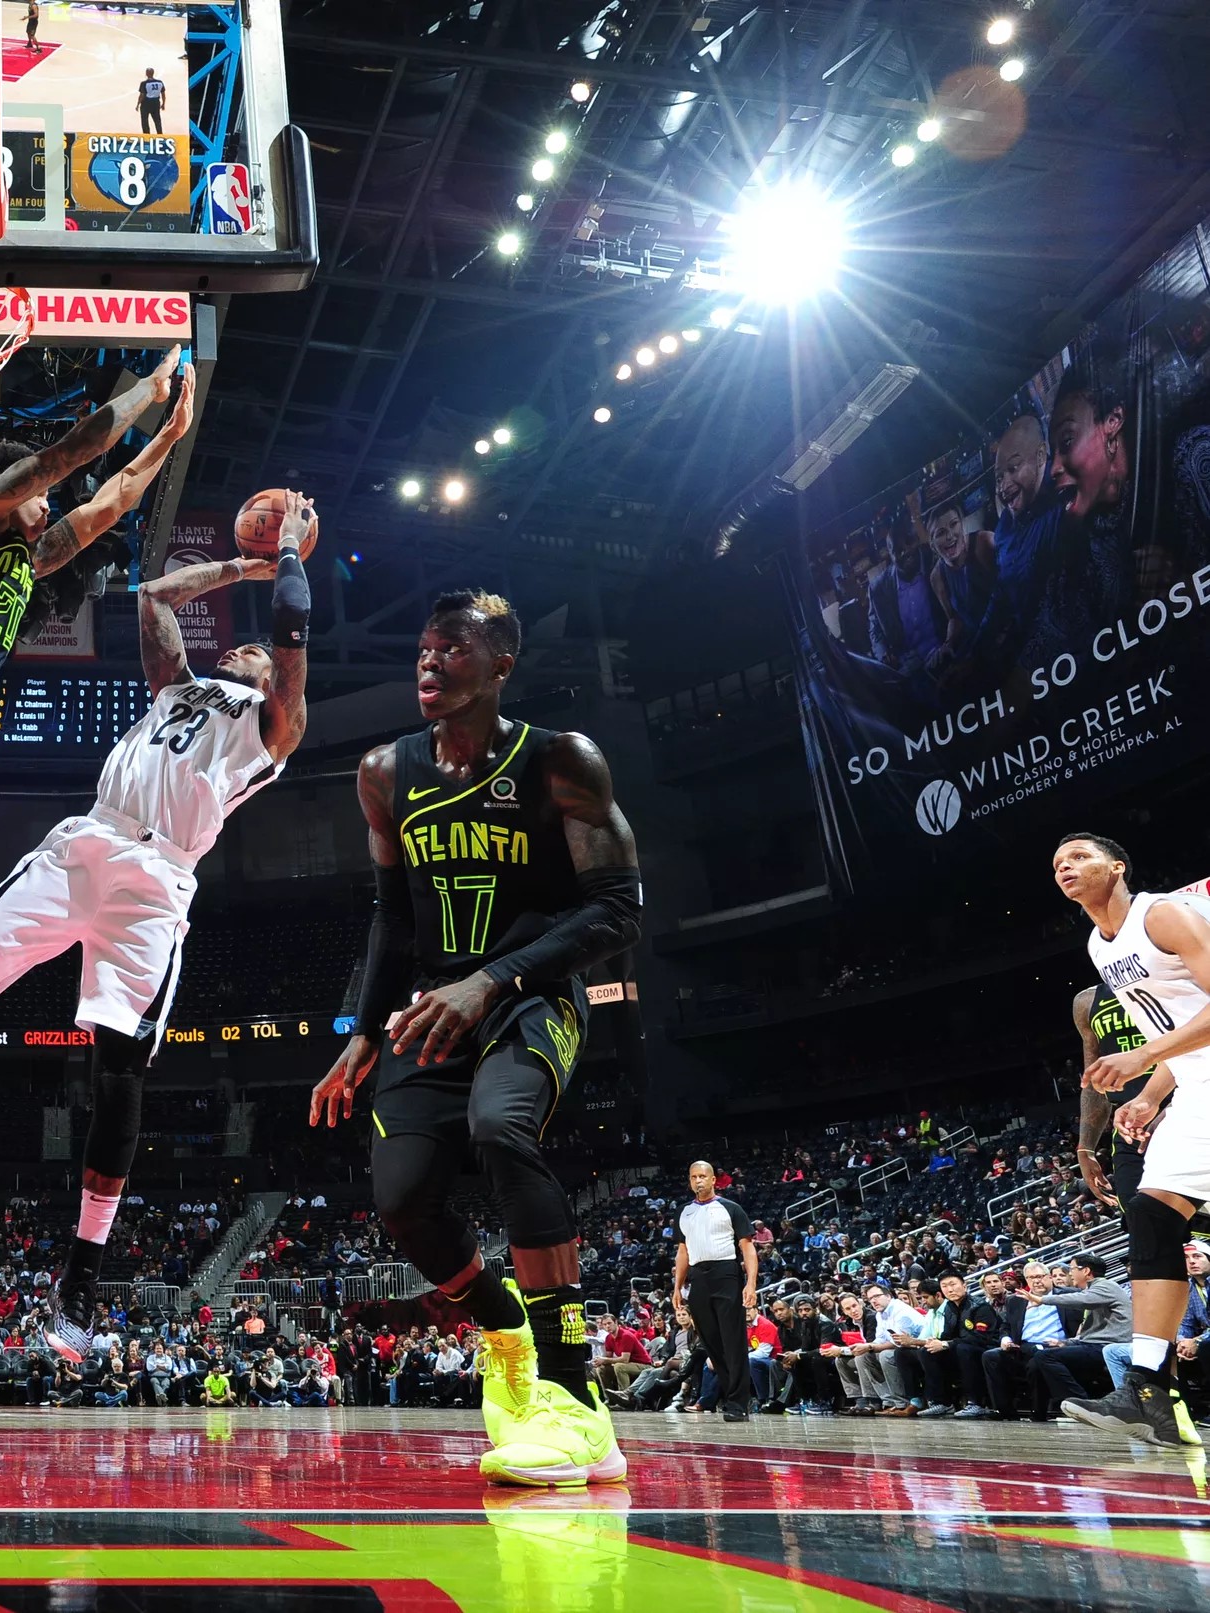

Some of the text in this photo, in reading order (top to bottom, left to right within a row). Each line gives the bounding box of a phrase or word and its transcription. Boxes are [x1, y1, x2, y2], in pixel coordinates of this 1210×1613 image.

[88, 136, 176, 155] GRIZZLIES
[119, 156, 147, 206] 8
[217, 220, 237, 234] NBA
[171, 526, 216, 536] TLANTA
[178, 601, 208, 615] 2015
[44, 625, 72, 635] VISION
[177, 617, 216, 627] OUTHEAST
[183, 640, 218, 650] AMPIONS
[847, 564, 1210, 785] SO MUCH. SO CLOSE
[24, 701, 53, 709] Chalmers
[172, 685, 252, 719] MEMPHIS
[11, 734, 43, 742] McLemore
[149, 702, 210, 755] 23
[959, 669, 1173, 792] WIND CREEK
[971, 716, 1183, 820] MONTGOMERY & WETUMPKA, AL
[1013, 727, 1126, 786] CASINO & HOTEL
[483, 801, 521, 810] sharecare
[403, 821, 529, 868] ATLANTA
[432, 875, 497, 954] 17
[1099, 953, 1150, 990] MEMPHIS
[1125, 988, 1176, 1035] 10
[24, 1031, 88, 1045] GRIZZLIES
[166, 1028, 205, 1043] Fouls
[221, 1026, 240, 1041] 02
[251, 1024, 282, 1039] TOL
[298, 1021, 309, 1036] 6
[1094, 1012, 1136, 1039] ATLA
[586, 1101, 616, 1110] 221-222
[825, 1127, 839, 1135] 101
